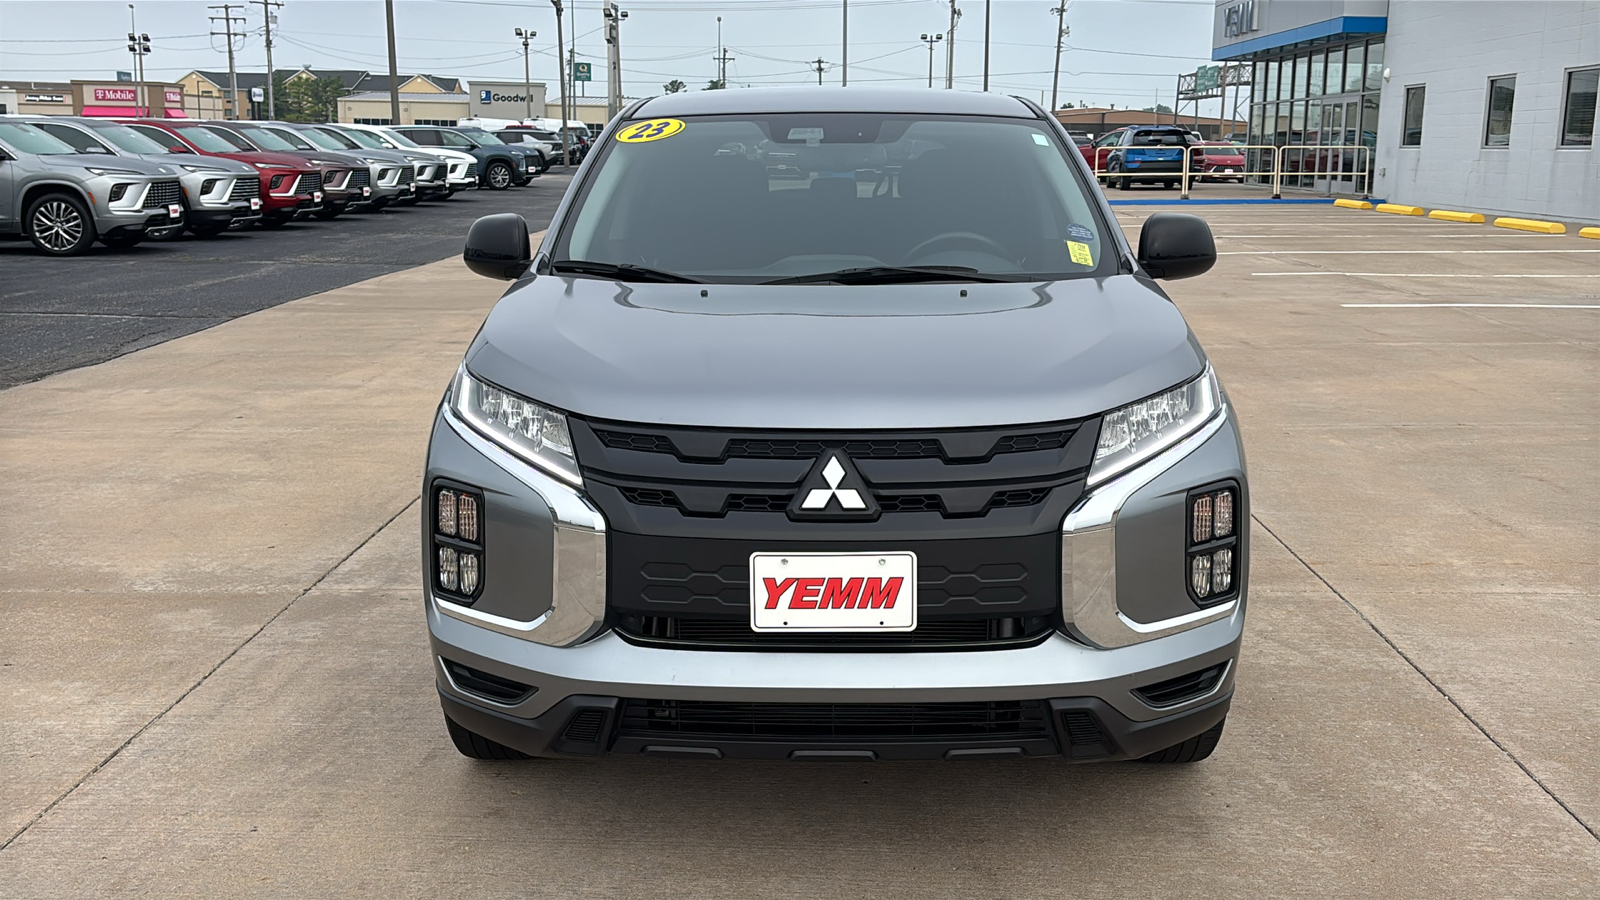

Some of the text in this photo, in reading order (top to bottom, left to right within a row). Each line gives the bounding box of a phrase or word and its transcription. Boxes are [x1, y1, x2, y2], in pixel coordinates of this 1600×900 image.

[492, 93, 534, 103] Goodwl
[627, 121, 671, 140] 23
[763, 577, 904, 609] YEMM
